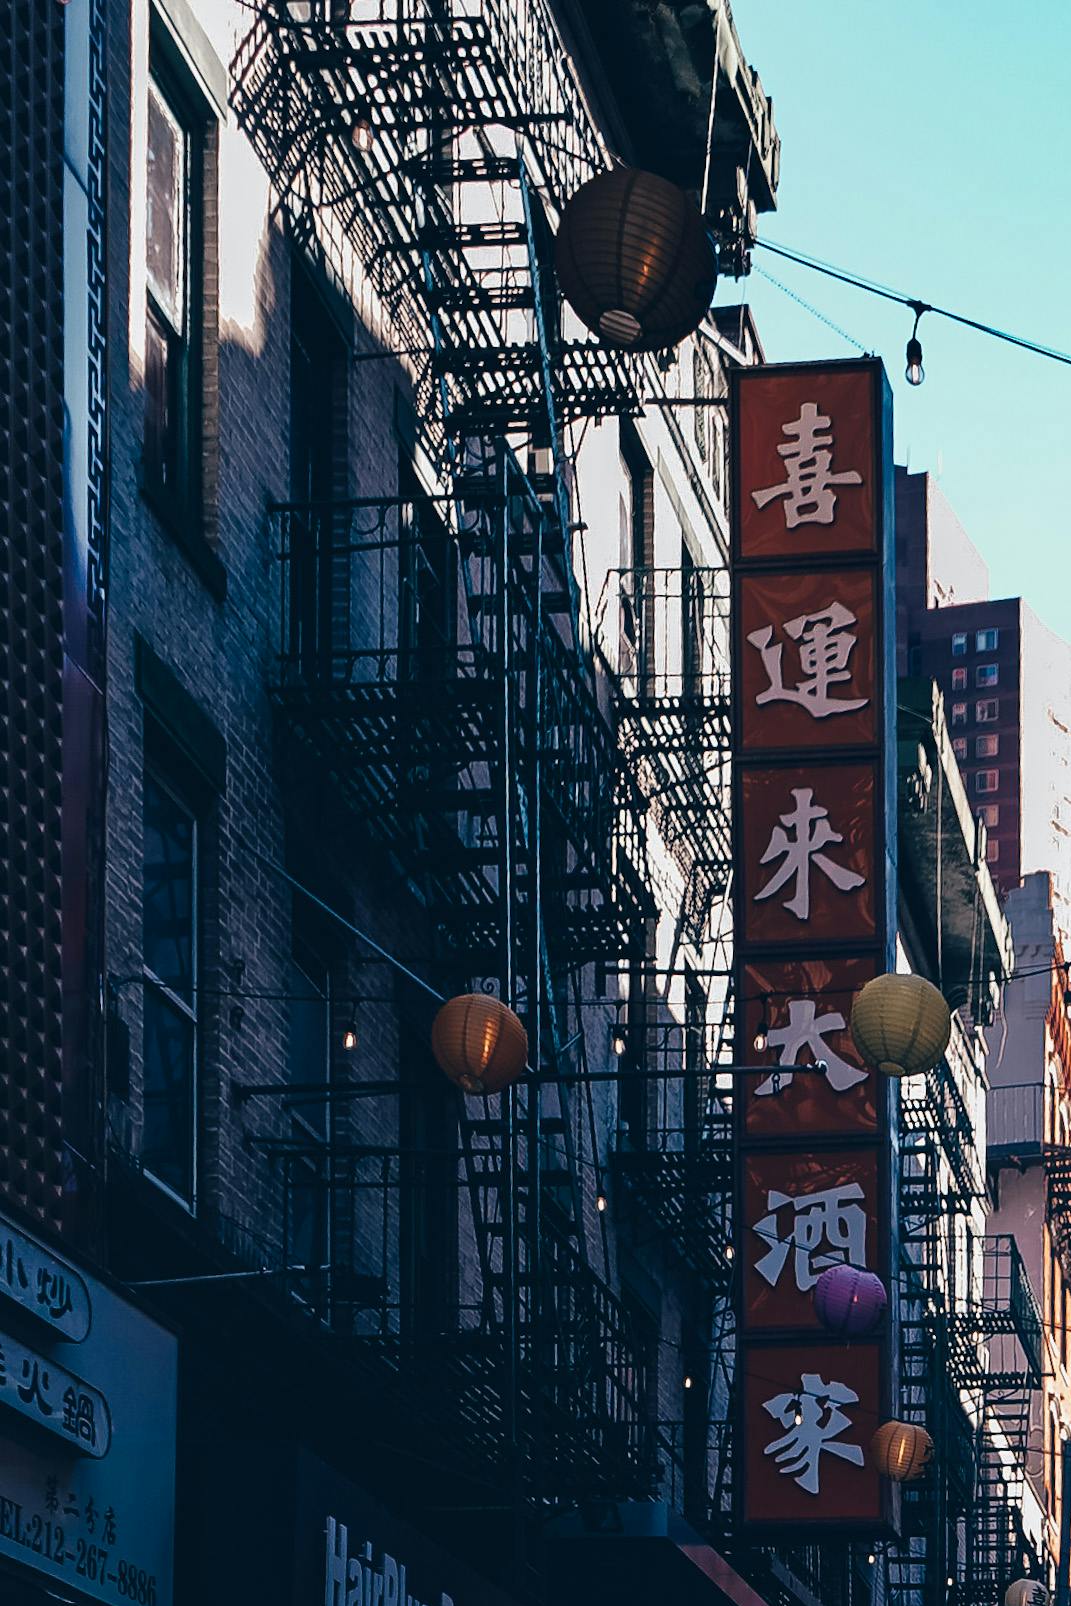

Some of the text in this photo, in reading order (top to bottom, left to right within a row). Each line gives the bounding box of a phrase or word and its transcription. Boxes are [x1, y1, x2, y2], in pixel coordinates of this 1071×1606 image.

[748, 403, 870, 1495] 喜運來大酒家
[0, 1345, 97, 1448] 火鍋
